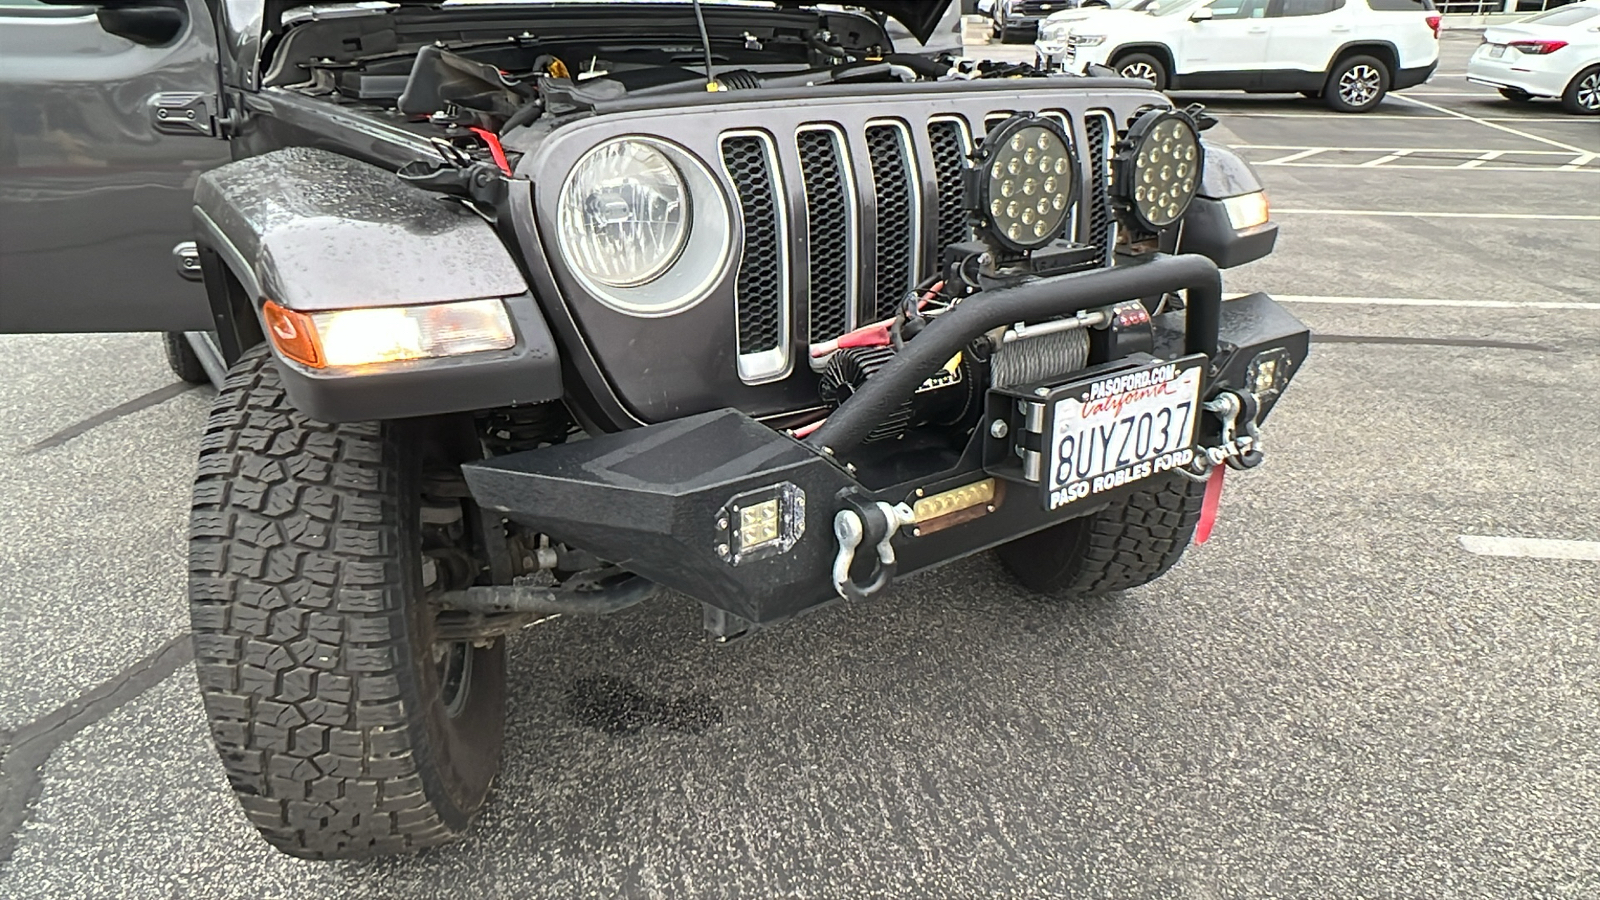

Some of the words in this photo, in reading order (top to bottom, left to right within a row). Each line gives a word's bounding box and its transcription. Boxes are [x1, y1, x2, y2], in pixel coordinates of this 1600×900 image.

[1081, 379, 1177, 419] California
[1089, 363, 1176, 400] PASOFORD.COM
[1055, 401, 1191, 485] 8UYZ037
[1050, 480, 1090, 509] PASO
[1092, 461, 1152, 494] ROBLES
[1153, 448, 1194, 474] FORD
